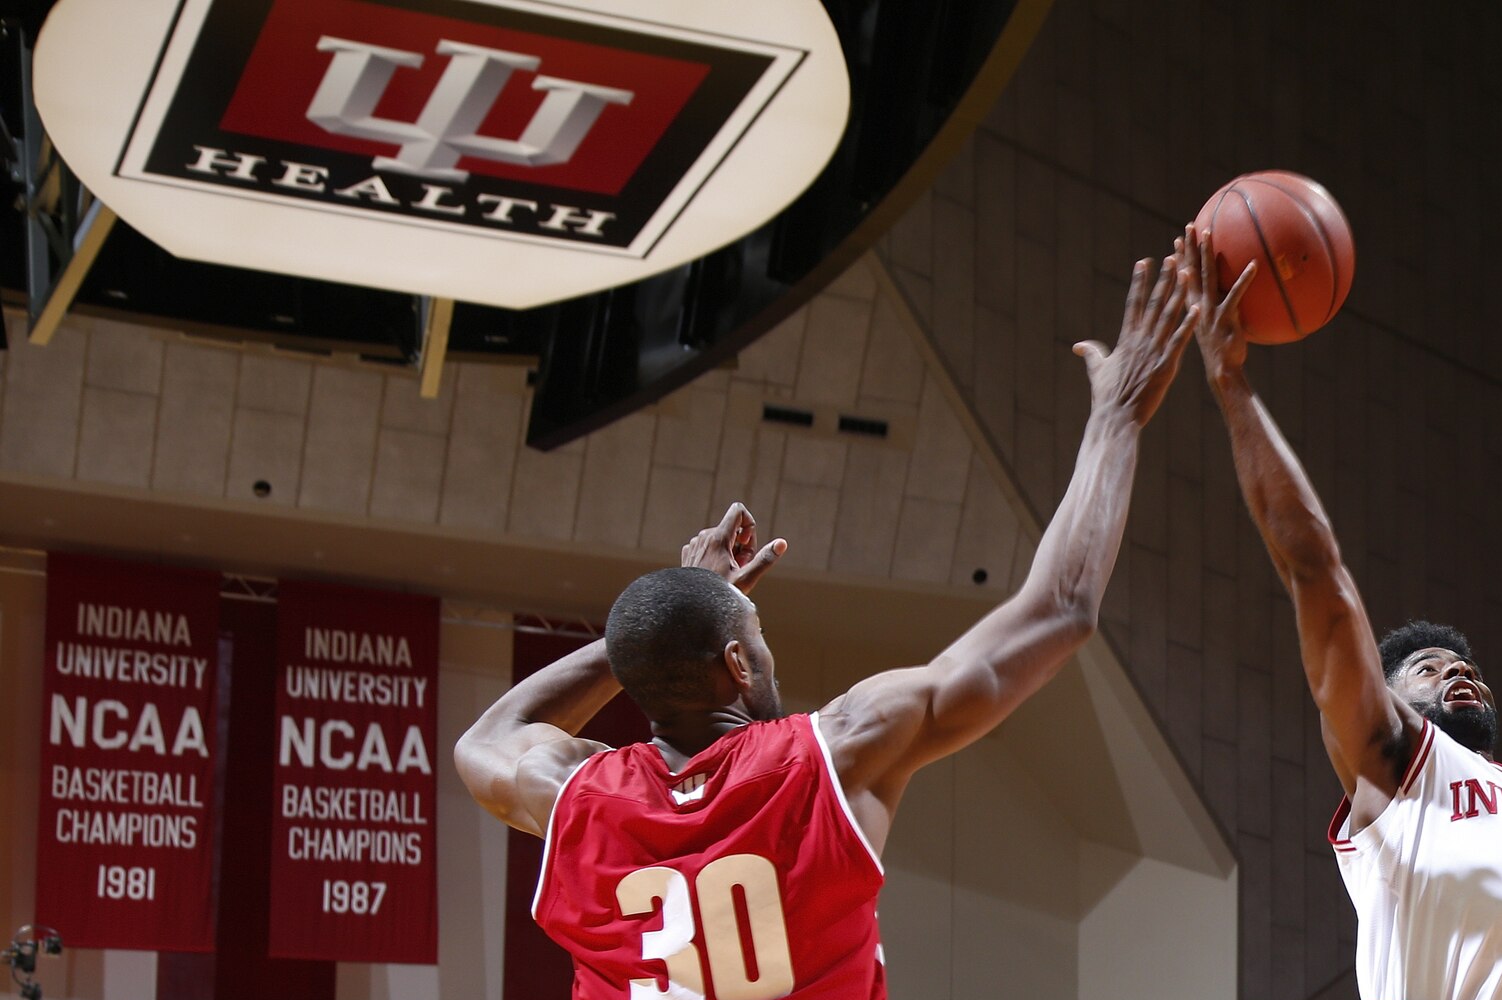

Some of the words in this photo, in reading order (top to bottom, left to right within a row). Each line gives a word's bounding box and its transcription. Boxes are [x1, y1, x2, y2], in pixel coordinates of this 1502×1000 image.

[185, 144, 617, 239] HEALTH
[77, 602, 192, 647] INDIANA
[56, 641, 207, 691] UNIVERSITY
[305, 627, 412, 668] INDIANA
[286, 666, 427, 708] UNIVERSITY
[50, 693, 208, 758] NCAA
[279, 715, 431, 775] NCAA
[51, 765, 203, 808] BASKETBALL
[282, 784, 427, 825] BASKETBALL
[56, 808, 196, 850] CHAMPIONS
[288, 826, 421, 865] CHAMPIONS
[97, 864, 155, 901] 1981
[322, 879, 387, 917] 1987
